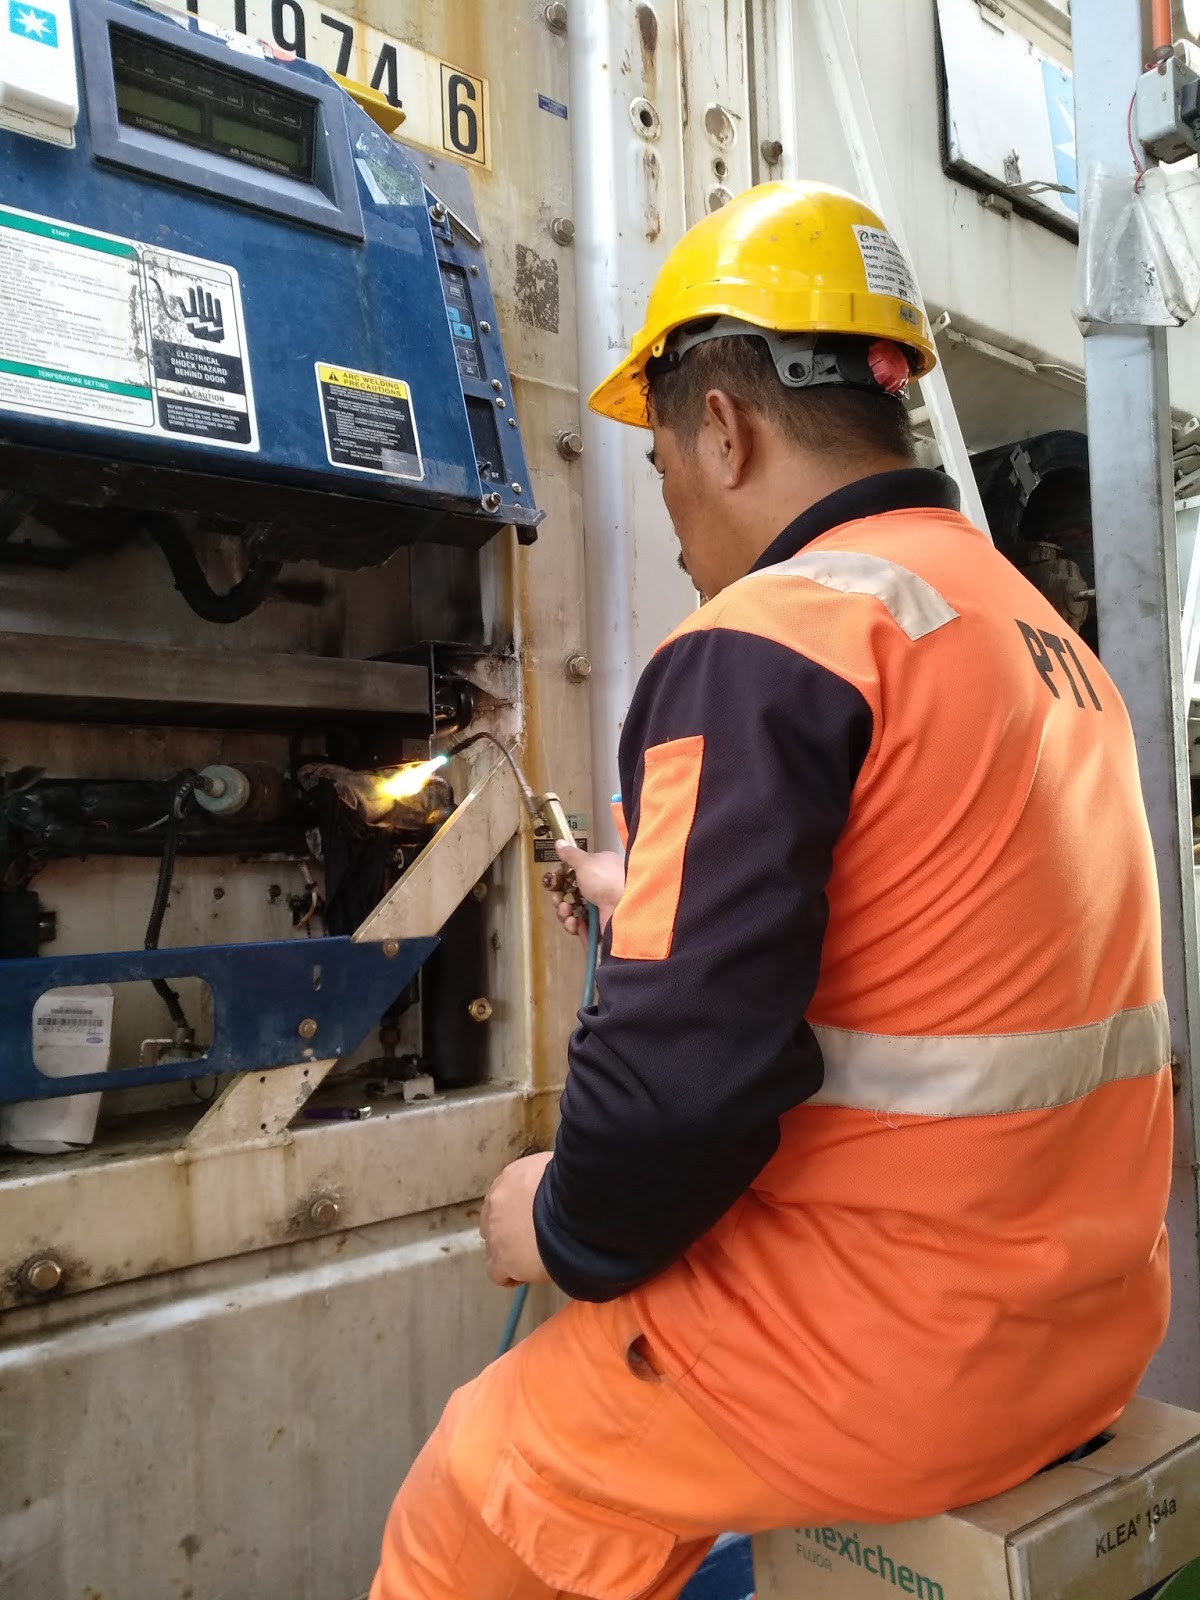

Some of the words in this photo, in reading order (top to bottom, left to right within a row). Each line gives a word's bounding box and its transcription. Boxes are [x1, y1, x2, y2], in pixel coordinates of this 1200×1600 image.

[187, 0, 402, 108] 974
[448, 74, 477, 154] 6
[51, 228, 70, 238] START
[861, 244, 884, 252] SAFETY
[868, 272, 884, 280] Expiry
[176, 350, 220, 365] ELECTRICAL
[171, 358, 196, 369] SHOCK
[198, 363, 228, 376] HAZARD
[37, 370, 82, 384] TEMPERATURE
[83, 379, 109, 389] SETTING
[175, 368, 202, 379] BEHIND
[205, 374, 226, 384] DOOR
[343, 372, 360, 381] ARC
[362, 376, 400, 390] WELDING
[193, 390, 225, 402] CAUTION
[344, 379, 402, 396] PRECAUTIONS
[1014, 619, 1102, 711] PTI
[1146, 1499, 1177, 1528] 134a
[795, 1543, 832, 1573] FLUOR
